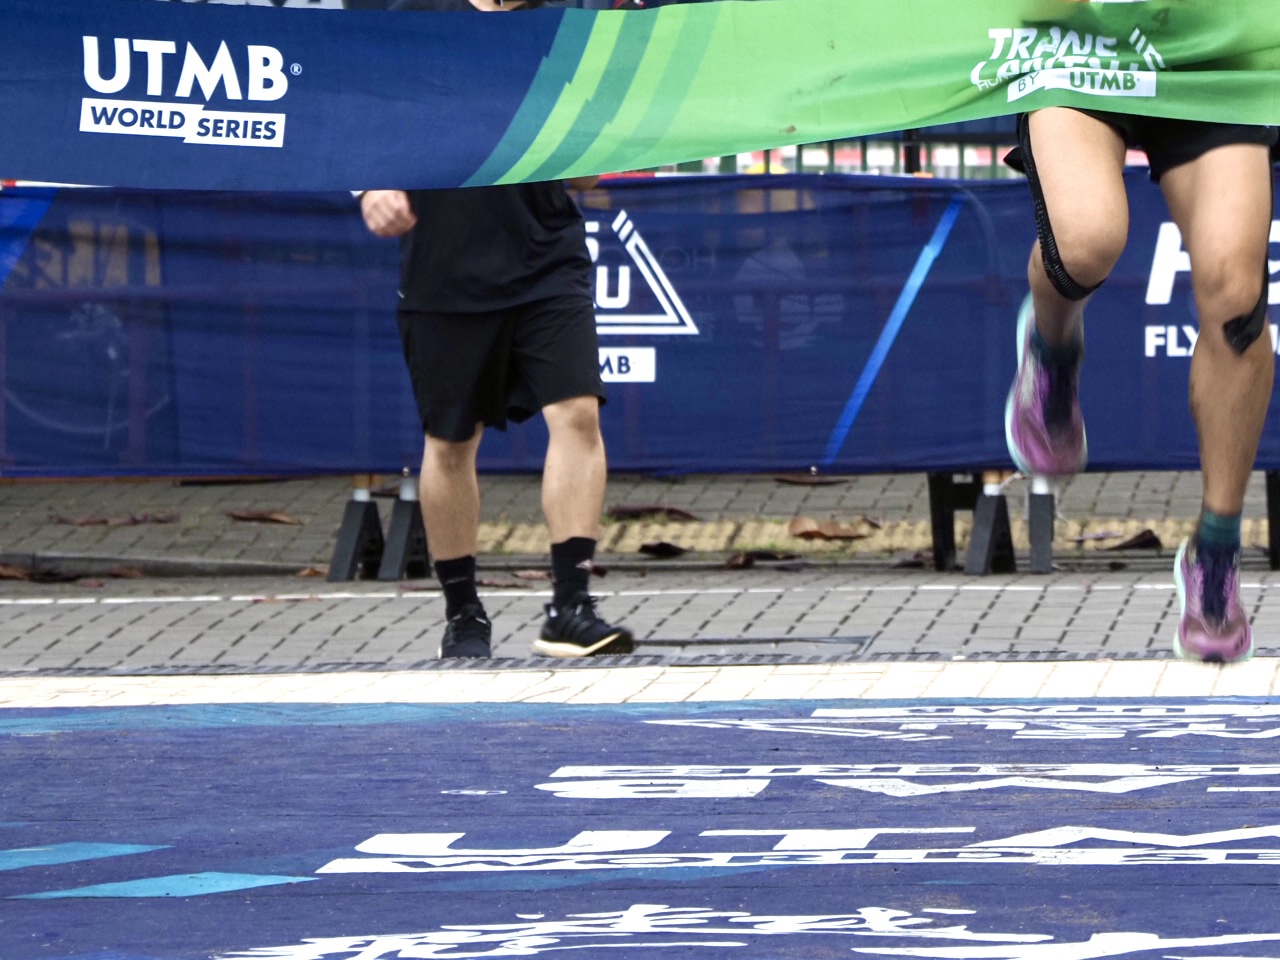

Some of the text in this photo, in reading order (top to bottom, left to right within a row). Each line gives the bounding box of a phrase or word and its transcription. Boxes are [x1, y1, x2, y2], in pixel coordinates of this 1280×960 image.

[1018, 71, 1136, 92] BY UTMB
[90, 106, 277, 140] WORLD SERIES
[391, 850, 1038, 869] WORLD
